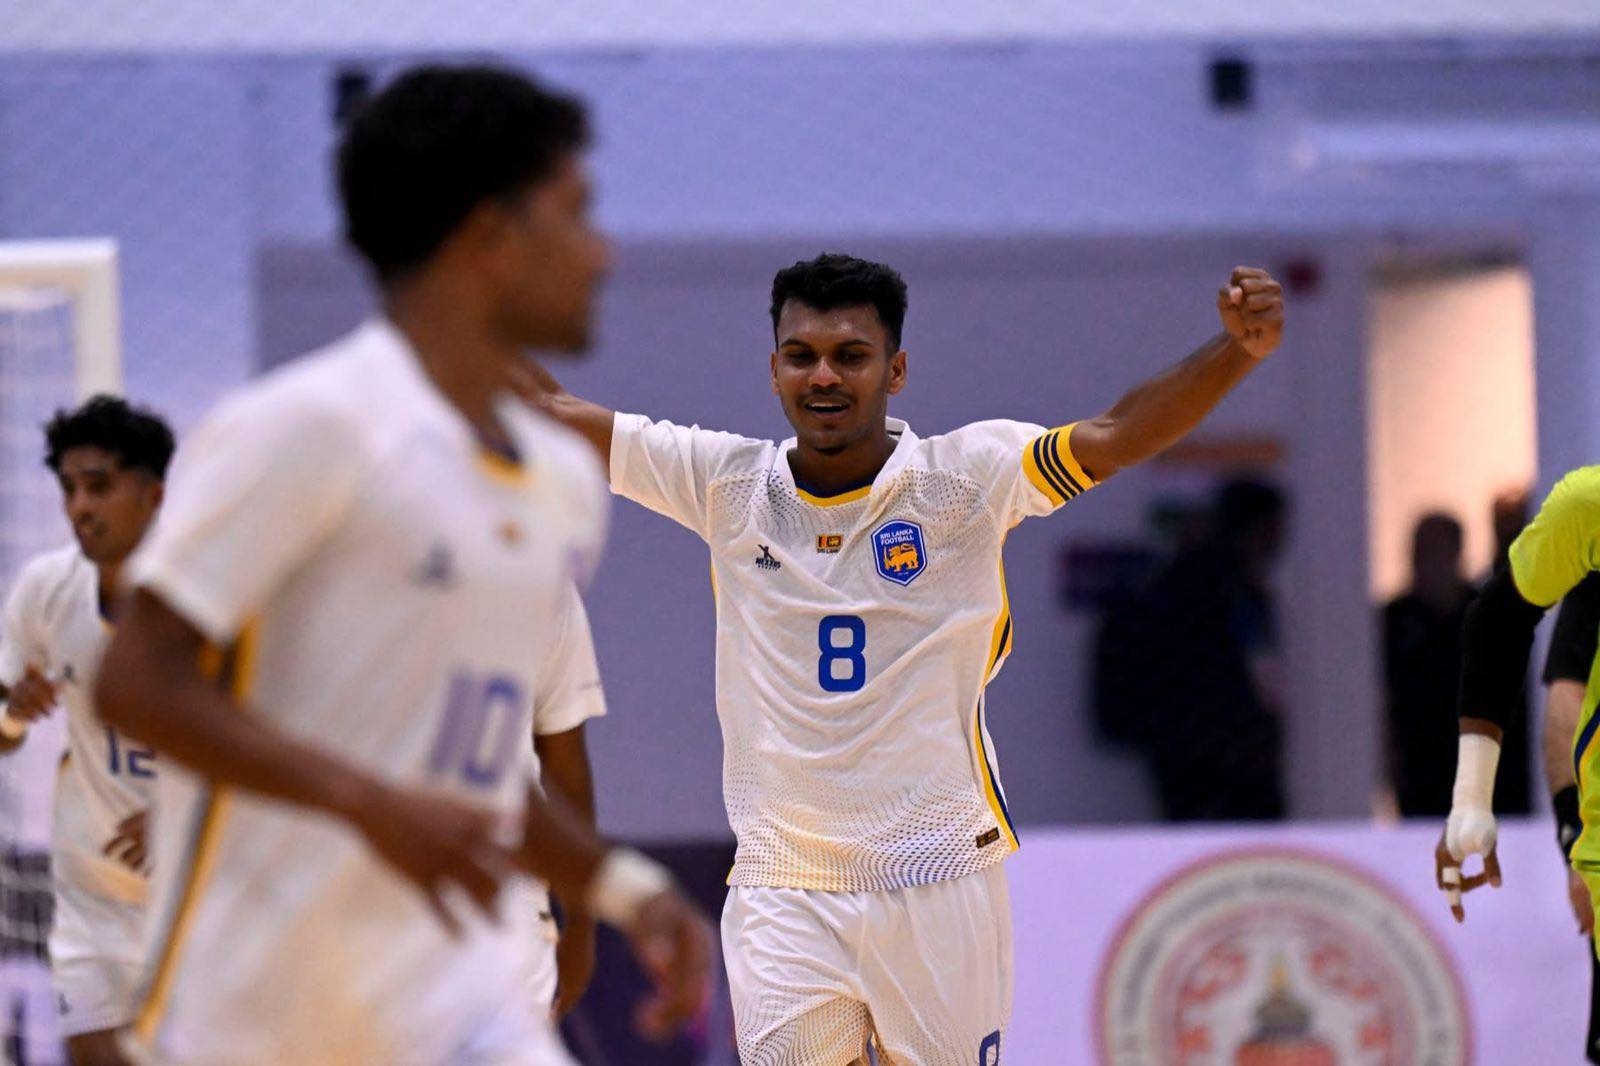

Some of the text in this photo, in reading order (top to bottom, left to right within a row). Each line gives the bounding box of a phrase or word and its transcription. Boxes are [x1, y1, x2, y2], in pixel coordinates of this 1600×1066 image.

[881, 535, 914, 545] FOOTBALL
[891, 529, 913, 538] LANKA
[818, 615, 866, 692] 8
[428, 669, 523, 787] 10
